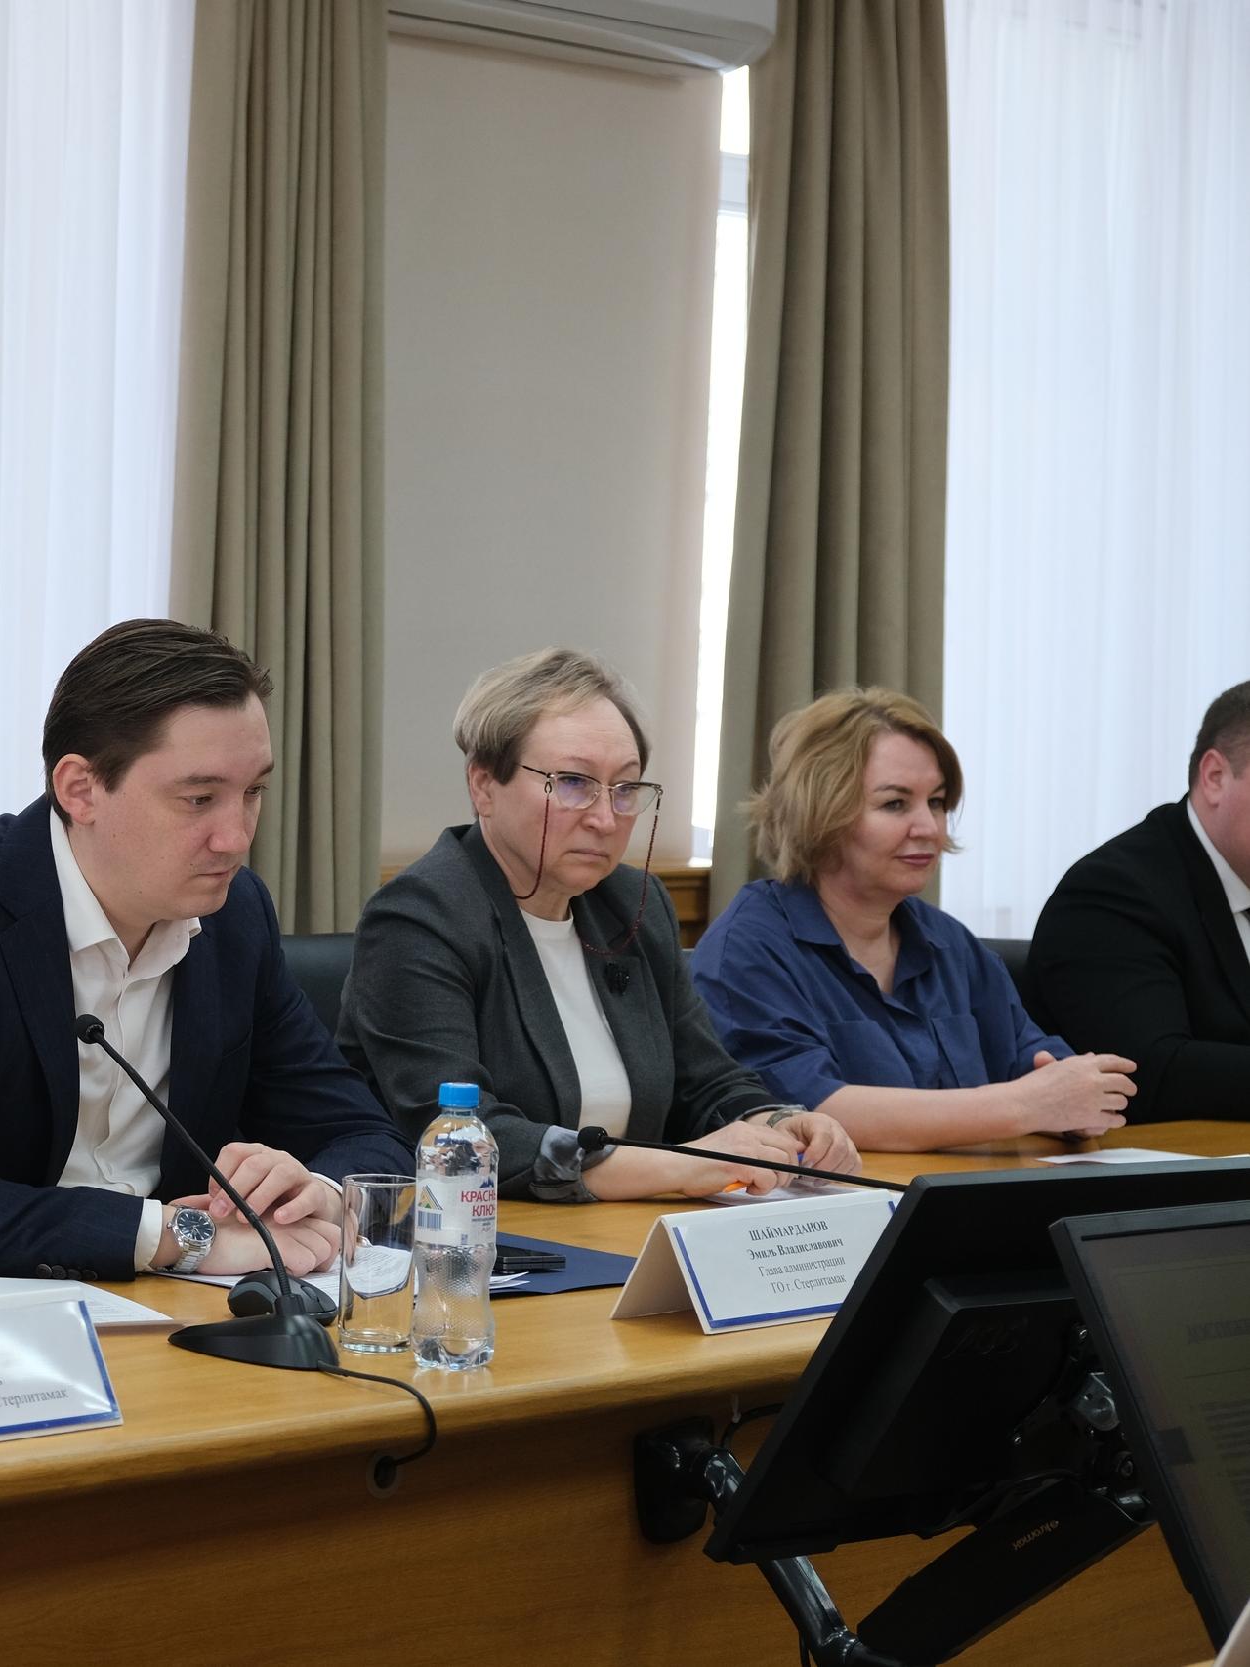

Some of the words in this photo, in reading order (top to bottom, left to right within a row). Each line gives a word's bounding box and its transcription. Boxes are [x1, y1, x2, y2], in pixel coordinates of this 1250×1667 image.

[472, 1204, 496, 1217] КЛЮ
[749, 1220, 828, 1241] ШАЙМАРДАНОВ
[747, 1247, 777, 1261] Эмиль
[777, 1239, 844, 1255] Владиславович
[758, 1265, 784, 1277] Глава
[784, 1257, 846, 1272] администрации
[770, 1280, 786, 1294] ГО
[794, 1275, 846, 1291] Стерлитамак
